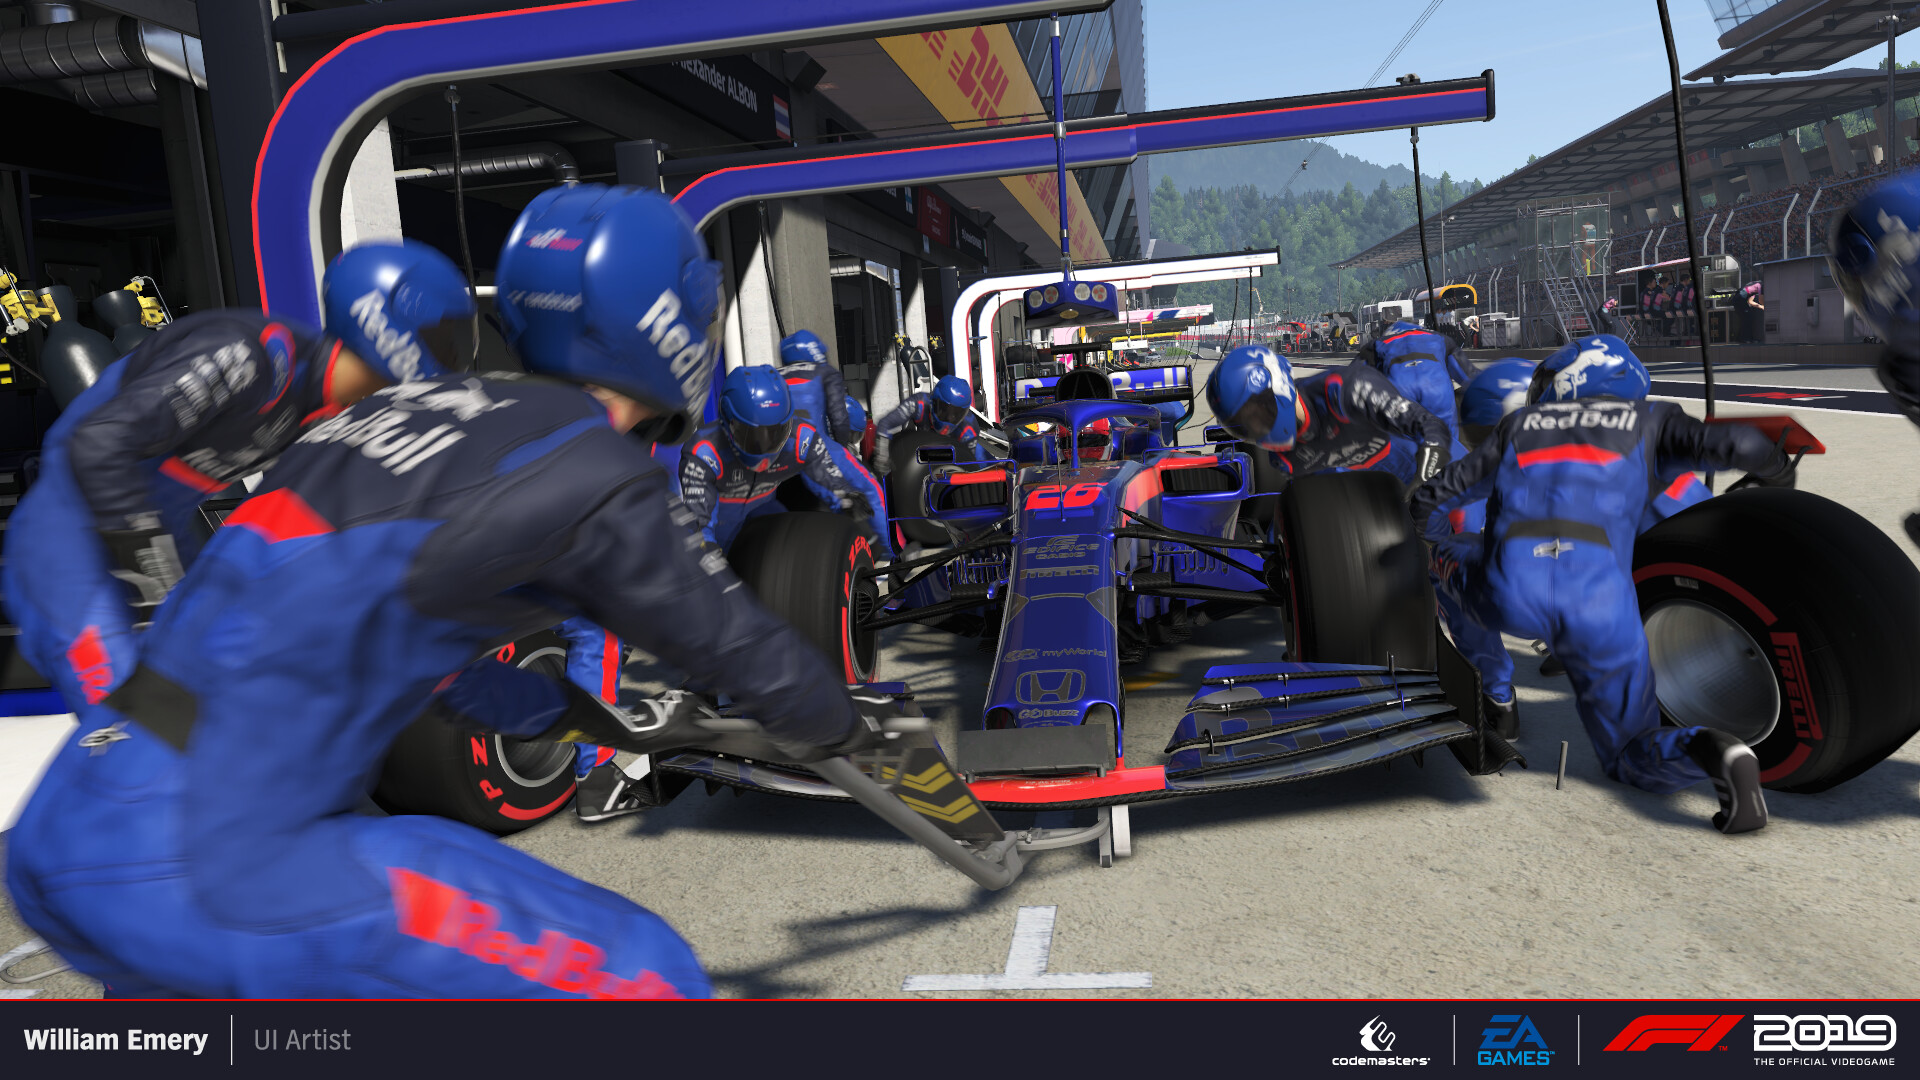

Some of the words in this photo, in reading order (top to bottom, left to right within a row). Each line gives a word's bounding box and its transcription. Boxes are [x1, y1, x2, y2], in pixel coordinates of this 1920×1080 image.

[677, 59, 726, 94] exander
[728, 75, 758, 113] ALBON
[1025, 482, 1109, 511] 26
[1022, 543, 1100, 555] EDIFICE
[1042, 648, 1107, 658] myWorld
[1769, 632, 1824, 741] PIRELLI
